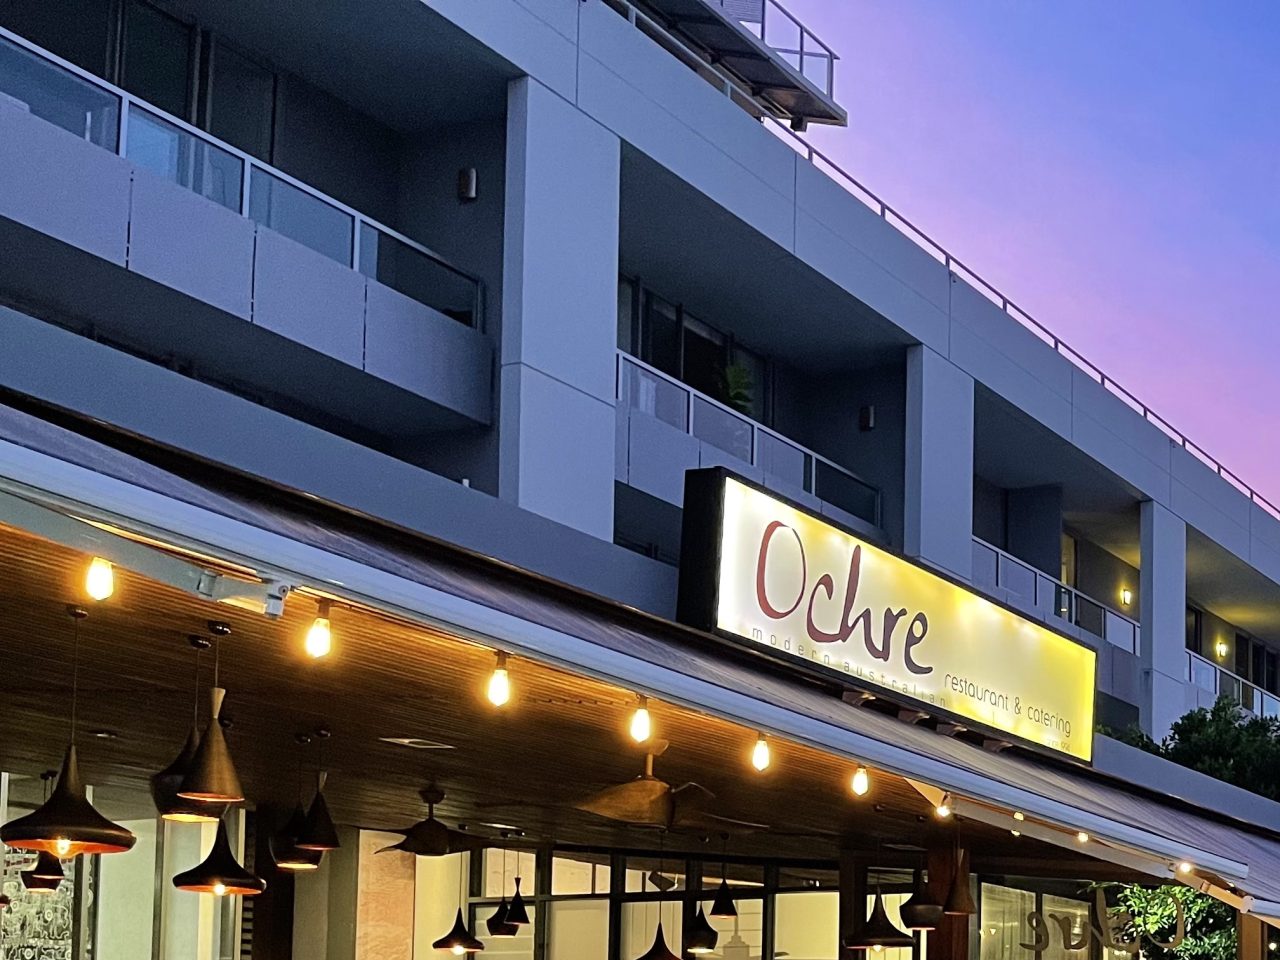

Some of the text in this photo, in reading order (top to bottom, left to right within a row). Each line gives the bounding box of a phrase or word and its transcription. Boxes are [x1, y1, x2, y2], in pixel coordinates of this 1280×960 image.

[756, 520, 934, 675] Ochre
[752, 626, 946, 707] modern australian
[944, 673, 1071, 738] restaurant & catering
